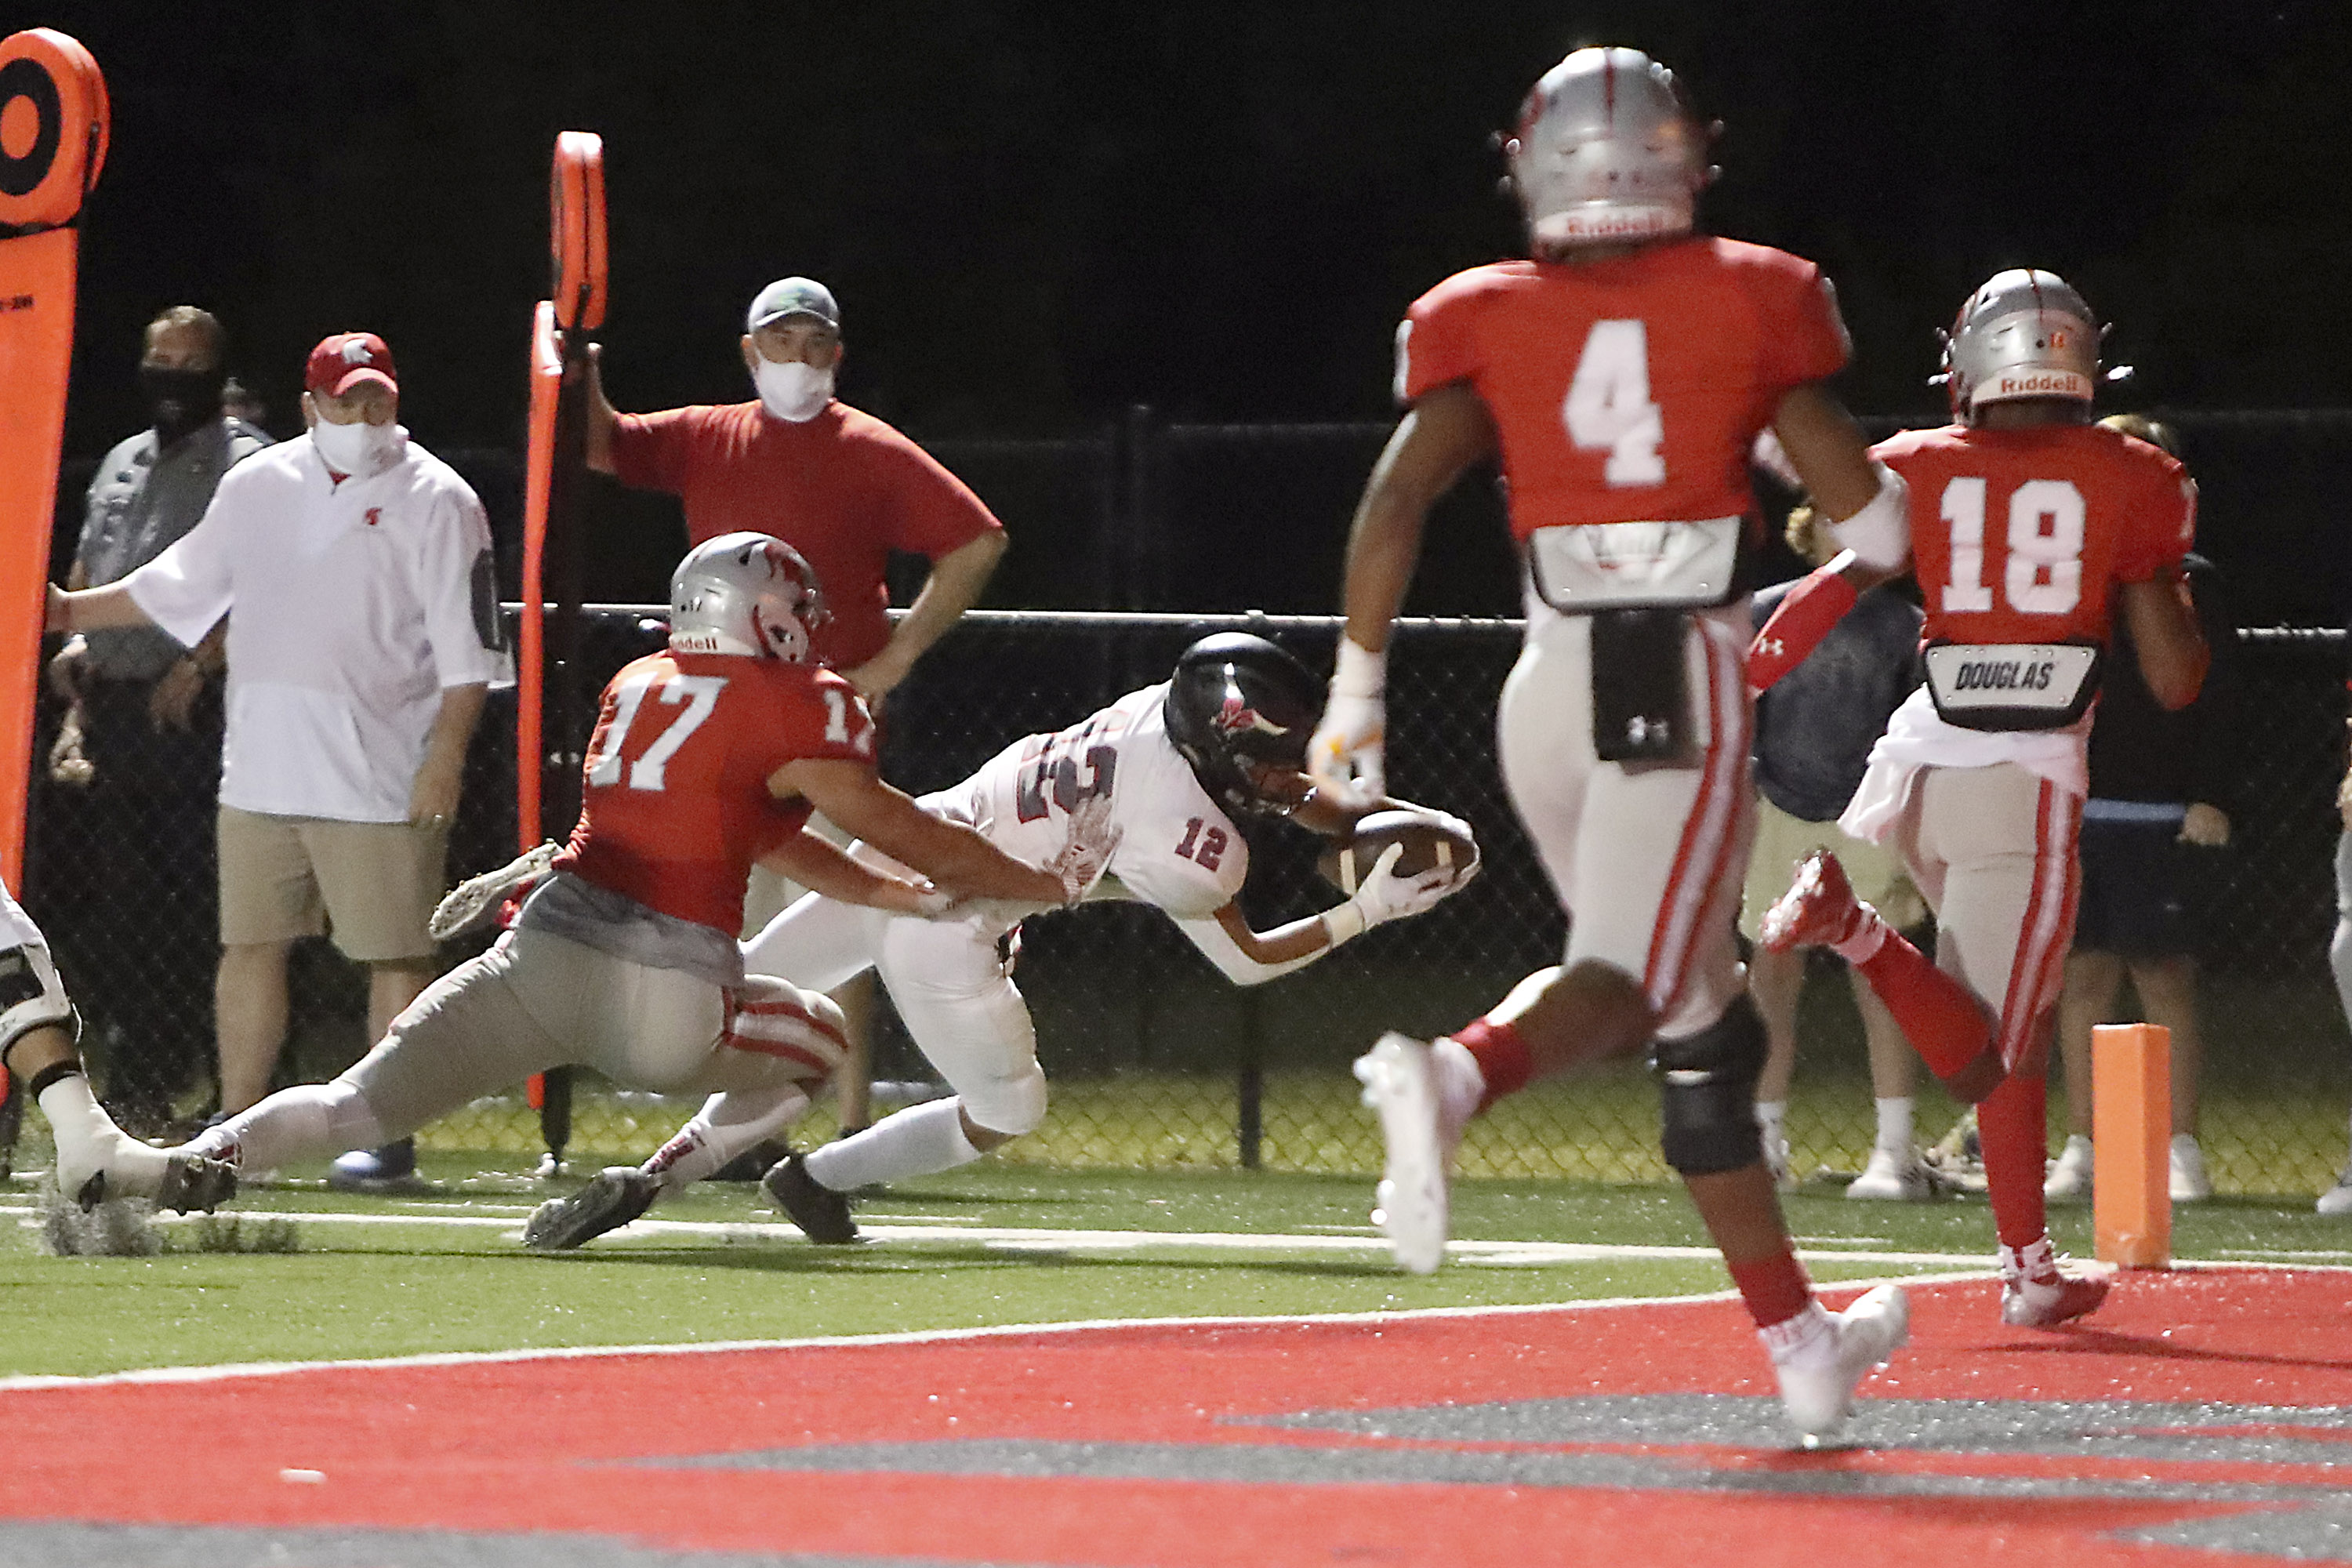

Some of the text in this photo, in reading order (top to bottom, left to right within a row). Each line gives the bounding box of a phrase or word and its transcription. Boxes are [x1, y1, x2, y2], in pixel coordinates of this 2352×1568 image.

[1562, 318, 1666, 488] 4
[2001, 375, 2078, 393] Riddell
[1940, 477, 2086, 615] 18
[1955, 661, 2055, 690] DOUGLAS
[590, 671, 730, 792] 17
[1174, 817, 1228, 873] 12
